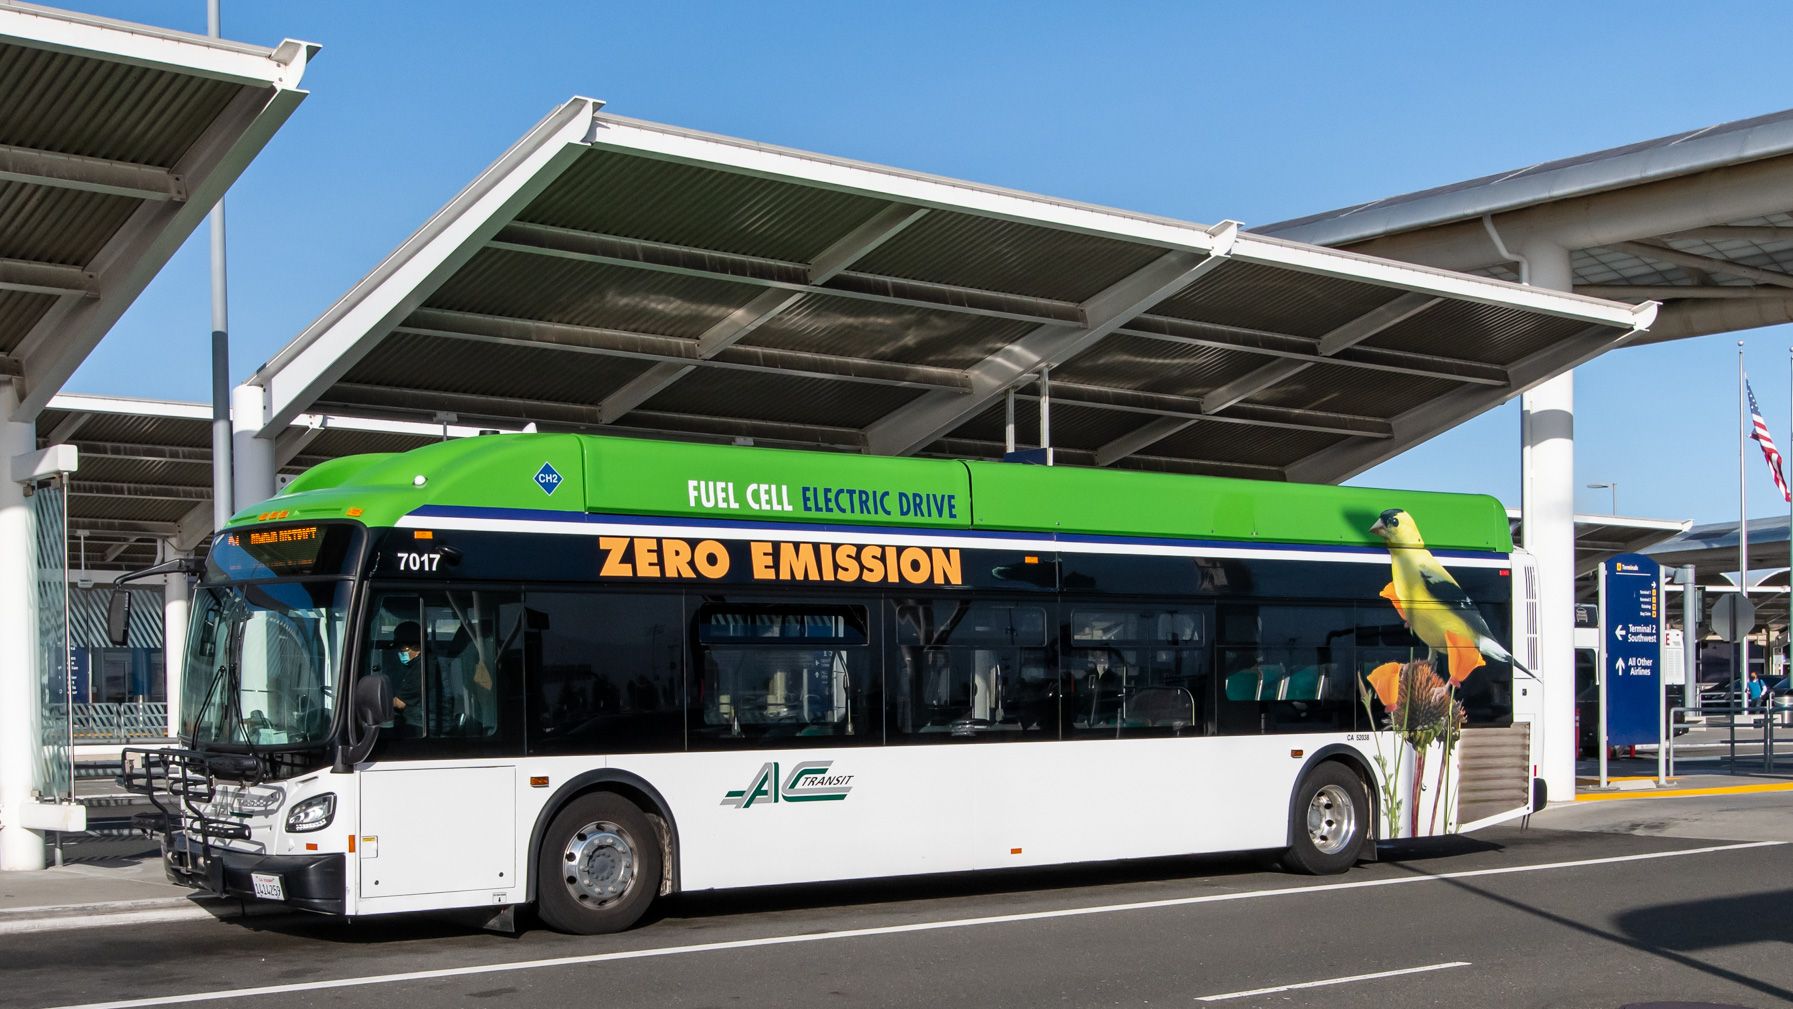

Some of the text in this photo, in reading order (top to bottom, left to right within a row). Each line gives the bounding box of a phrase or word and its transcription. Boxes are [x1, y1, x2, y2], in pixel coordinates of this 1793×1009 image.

[538, 473, 558, 483] CH2
[688, 480, 957, 519] FUEL CELL ELECTRIC DRIVE
[397, 552, 441, 572] 7017
[599, 536, 963, 585] ZERO EMISSION
[1628, 624, 1657, 633] Terminal 2
[1628, 634, 1657, 643] Southwest
[1628, 657, 1653, 667] All Other
[1630, 667, 1651, 676] Airlines
[720, 760, 855, 808] AC TRANSIT
